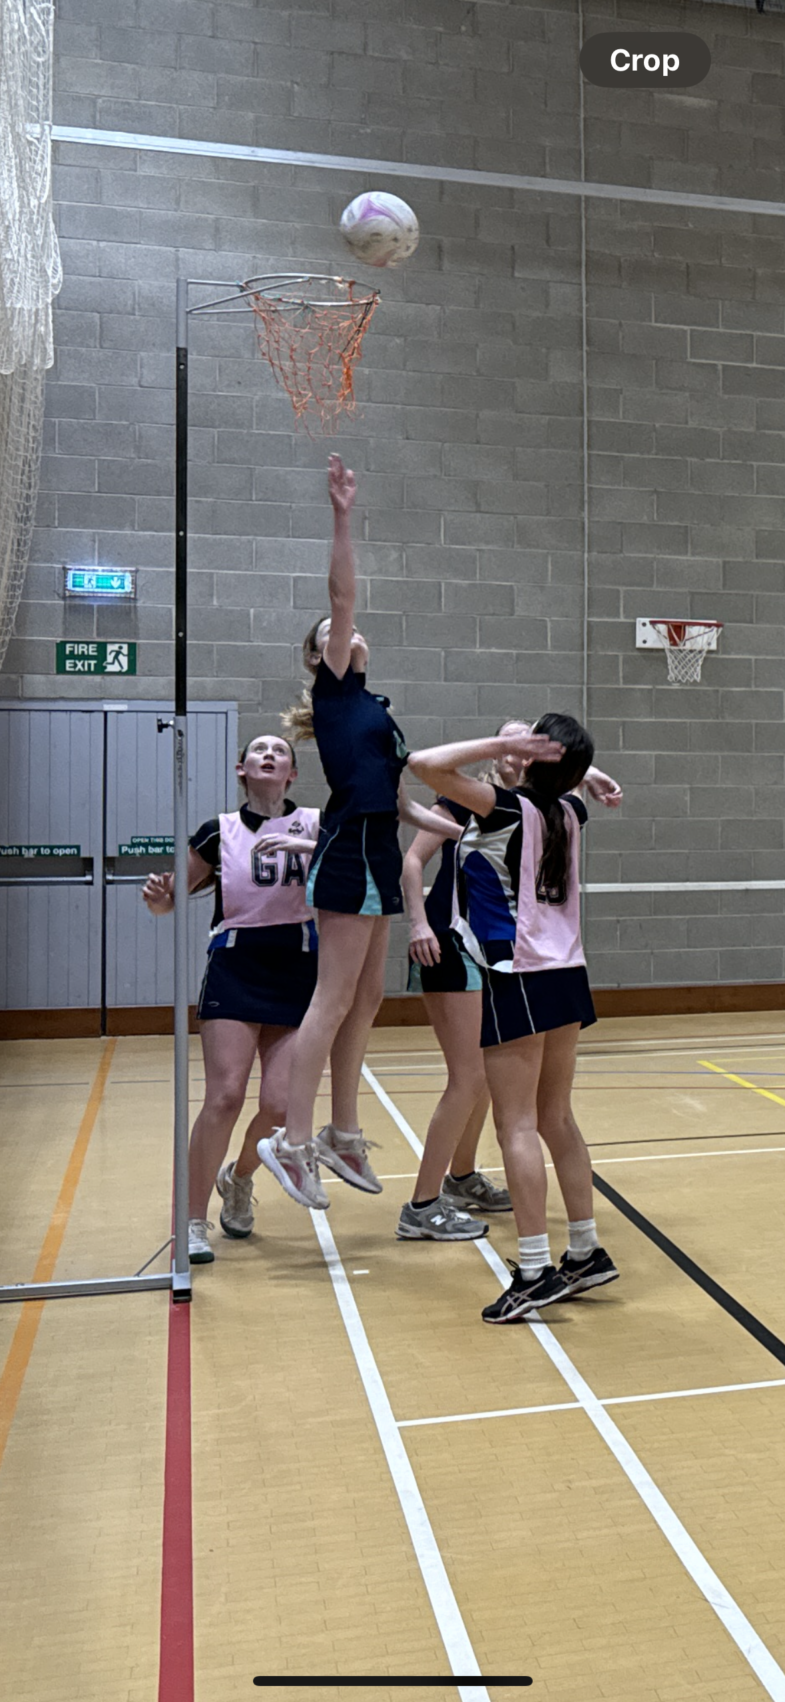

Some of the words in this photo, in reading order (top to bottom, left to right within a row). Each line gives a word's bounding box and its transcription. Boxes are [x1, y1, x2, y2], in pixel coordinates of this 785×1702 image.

[65, 643, 98, 656] FIRE
[65, 660, 98, 672] EXIT
[0, 847, 20, 855] ush
[21, 847, 38, 855] bar
[40, 847, 51, 855] to
[52, 847, 78, 857] open
[121, 845, 146, 854] Push
[147, 845, 164, 854] bar
[251, 848, 306, 887] GA
[430, 1214, 447, 1226] N
